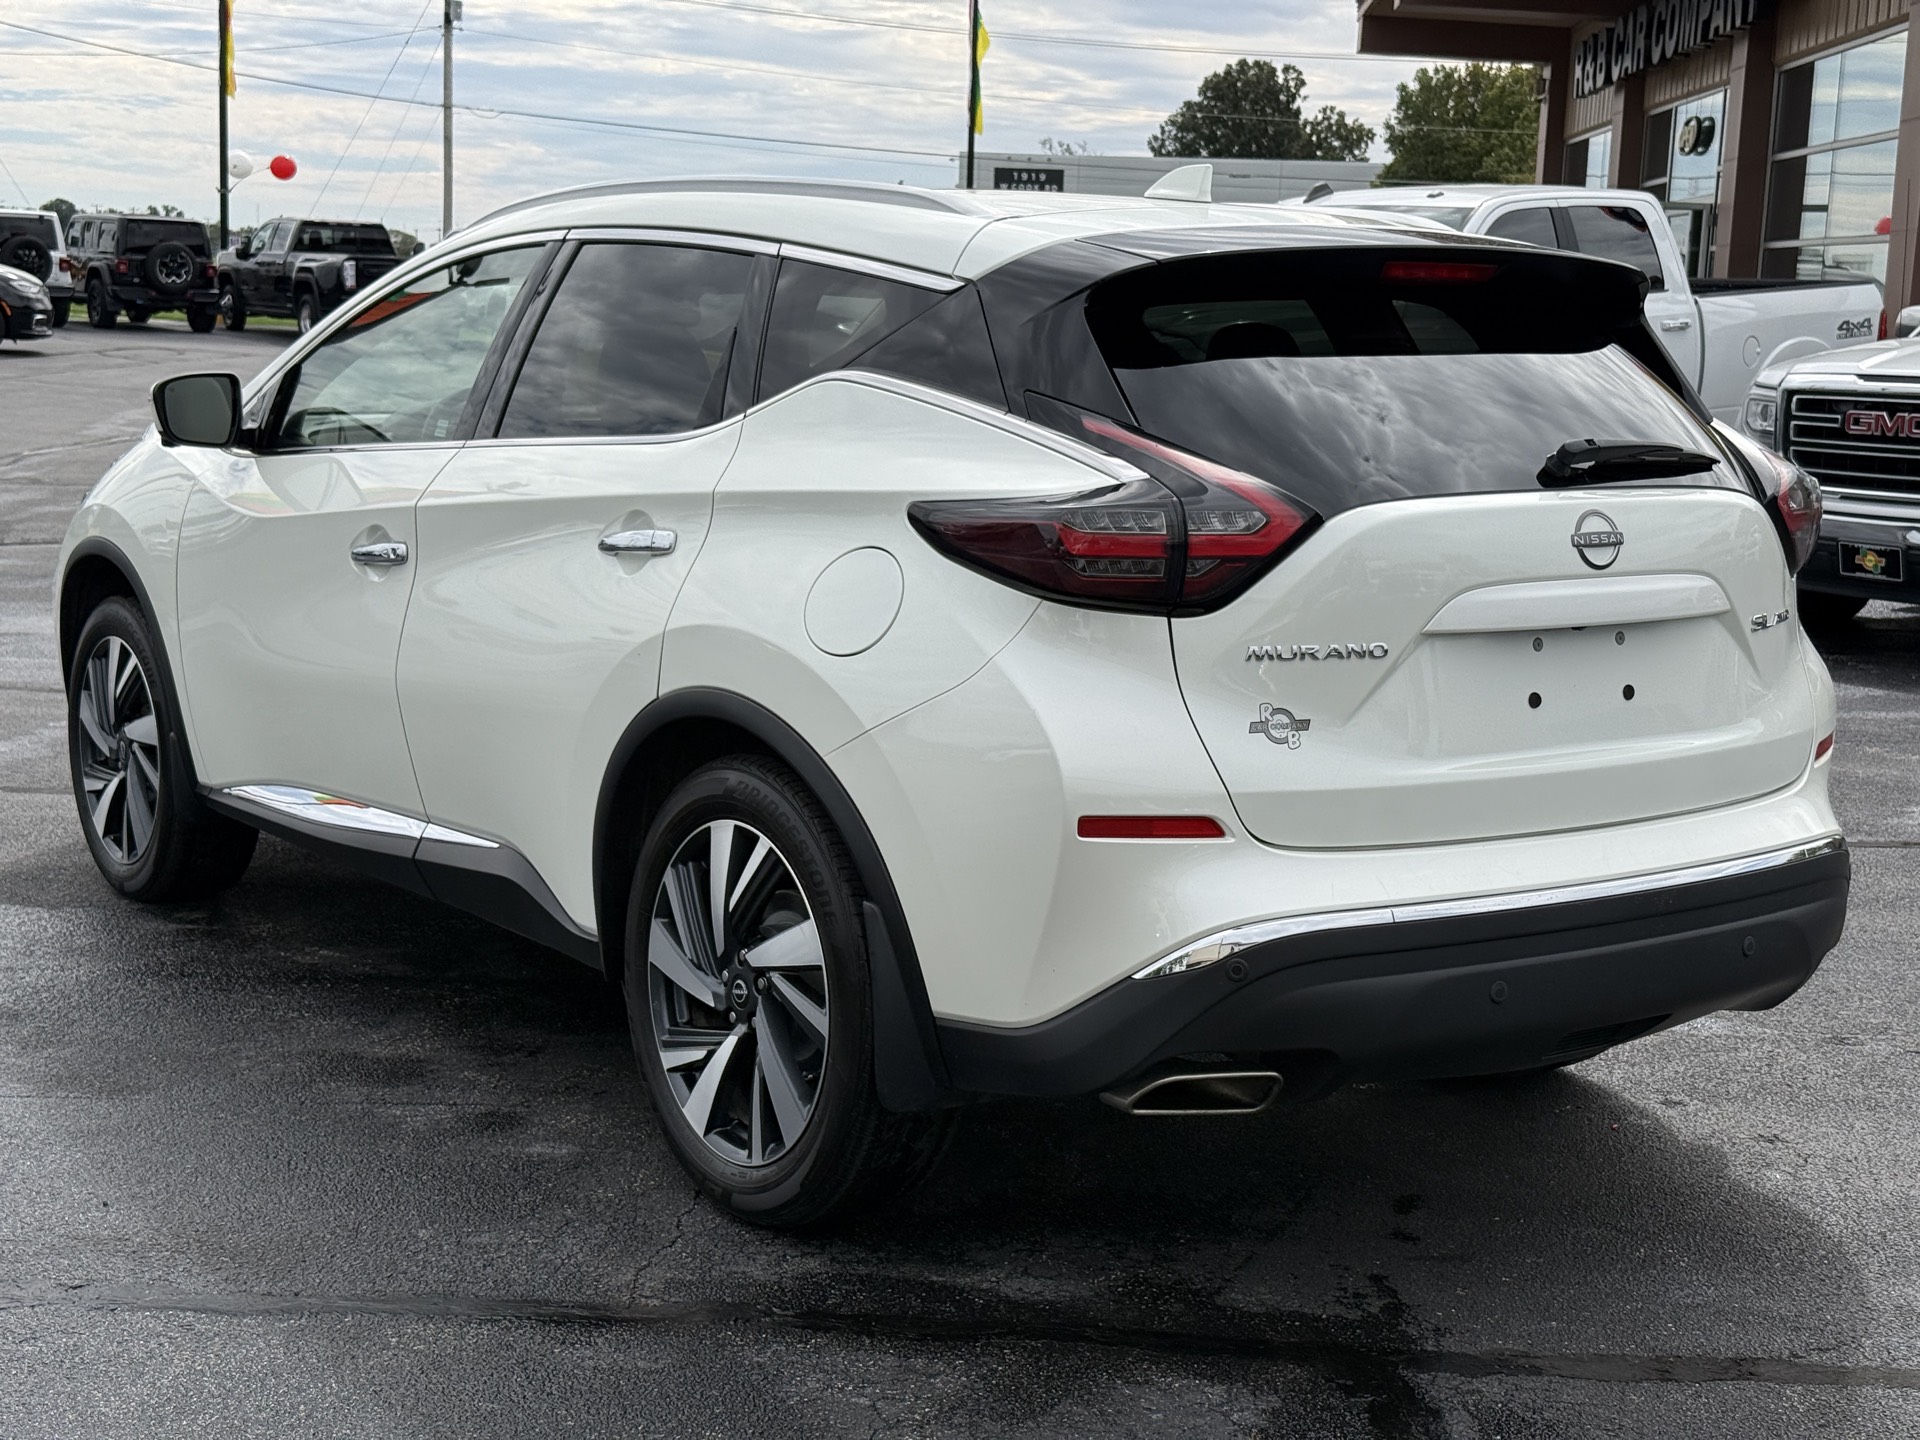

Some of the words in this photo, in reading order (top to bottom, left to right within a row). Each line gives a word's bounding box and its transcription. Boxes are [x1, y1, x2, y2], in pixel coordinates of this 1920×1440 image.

[1573, 29, 1608, 99] R&B
[1611, 4, 1648, 83] CAR
[1651, 0, 1755, 65] COMPAN
[1013, 171, 1047, 182] 1919
[1836, 317, 1873, 333] 4x4
[1845, 410, 1920, 438] GMC
[1573, 533, 1624, 546] NISSAN
[1245, 642, 1389, 662] MURANO
[1251, 723, 1268, 731] CAR
[1269, 721, 1308, 731] COMPANY
